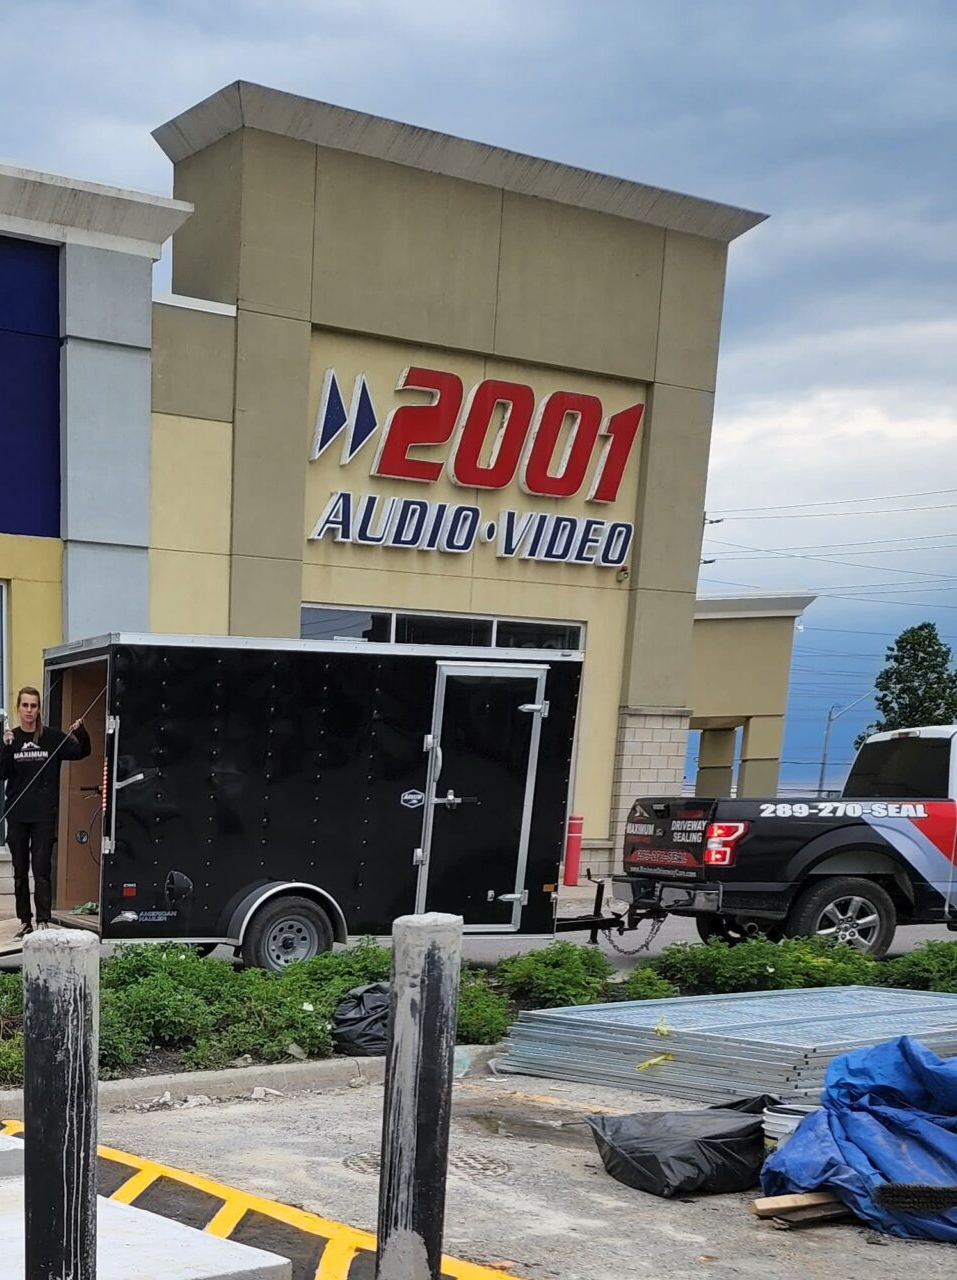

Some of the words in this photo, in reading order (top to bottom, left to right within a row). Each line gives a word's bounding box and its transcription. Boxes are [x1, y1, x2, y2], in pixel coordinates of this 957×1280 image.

[370, 366, 645, 504] 2001
[13, 750, 49, 759] MAXIMUM
[759, 802, 928, 818] 289-270-SEAL
[626, 822, 655, 835] MAXIMUM
[670, 820, 708, 831] DRIVEWAY
[672, 832, 703, 843] SEALING
